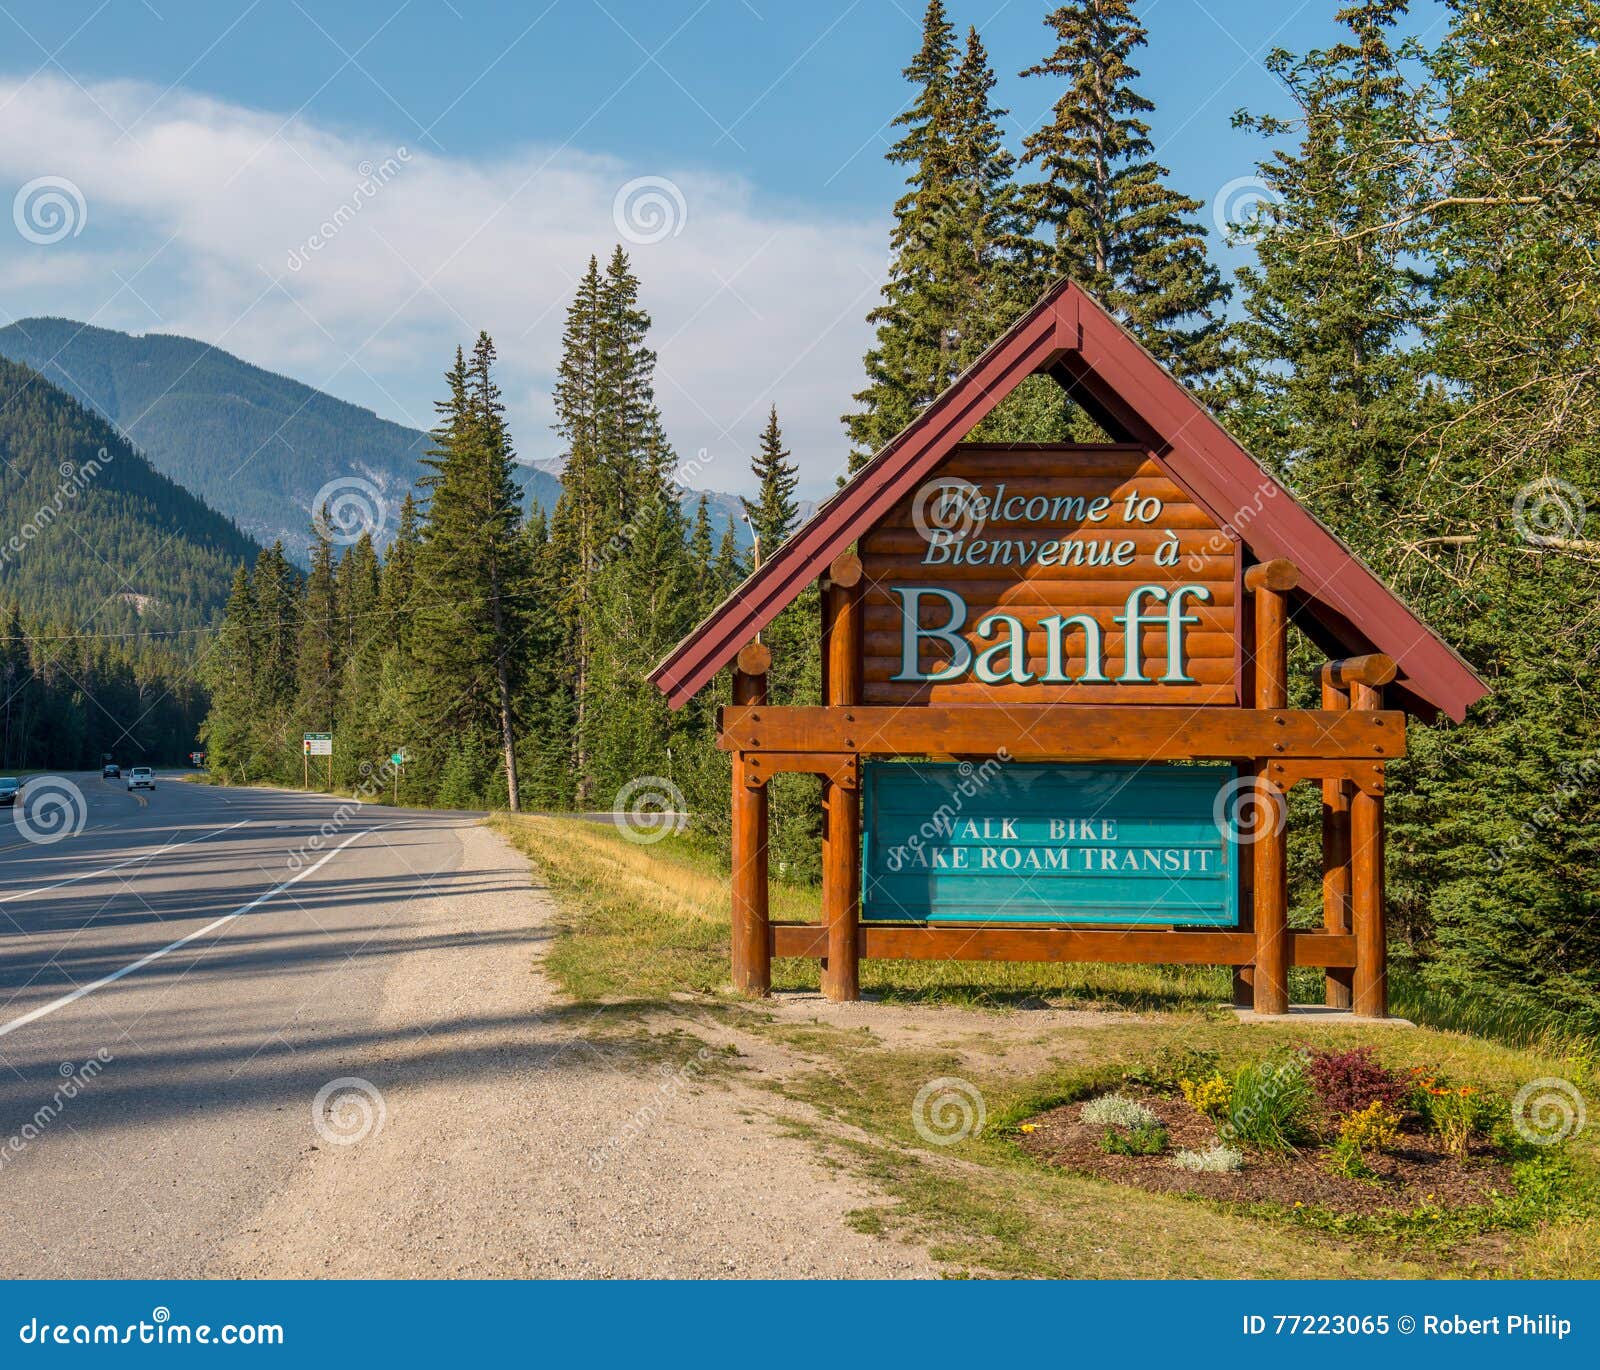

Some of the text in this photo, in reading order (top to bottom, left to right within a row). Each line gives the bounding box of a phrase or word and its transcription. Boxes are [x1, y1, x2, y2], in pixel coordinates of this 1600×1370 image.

[938, 483, 1163, 523] Welcome to
[920, 527, 1181, 567] Bienvenue à
[889, 584, 1212, 684] Banff
[932, 816, 1119, 841] WALK BIKE
[980, 846, 1070, 871] ROAM
[1078, 848, 1214, 872] TRANSIT
